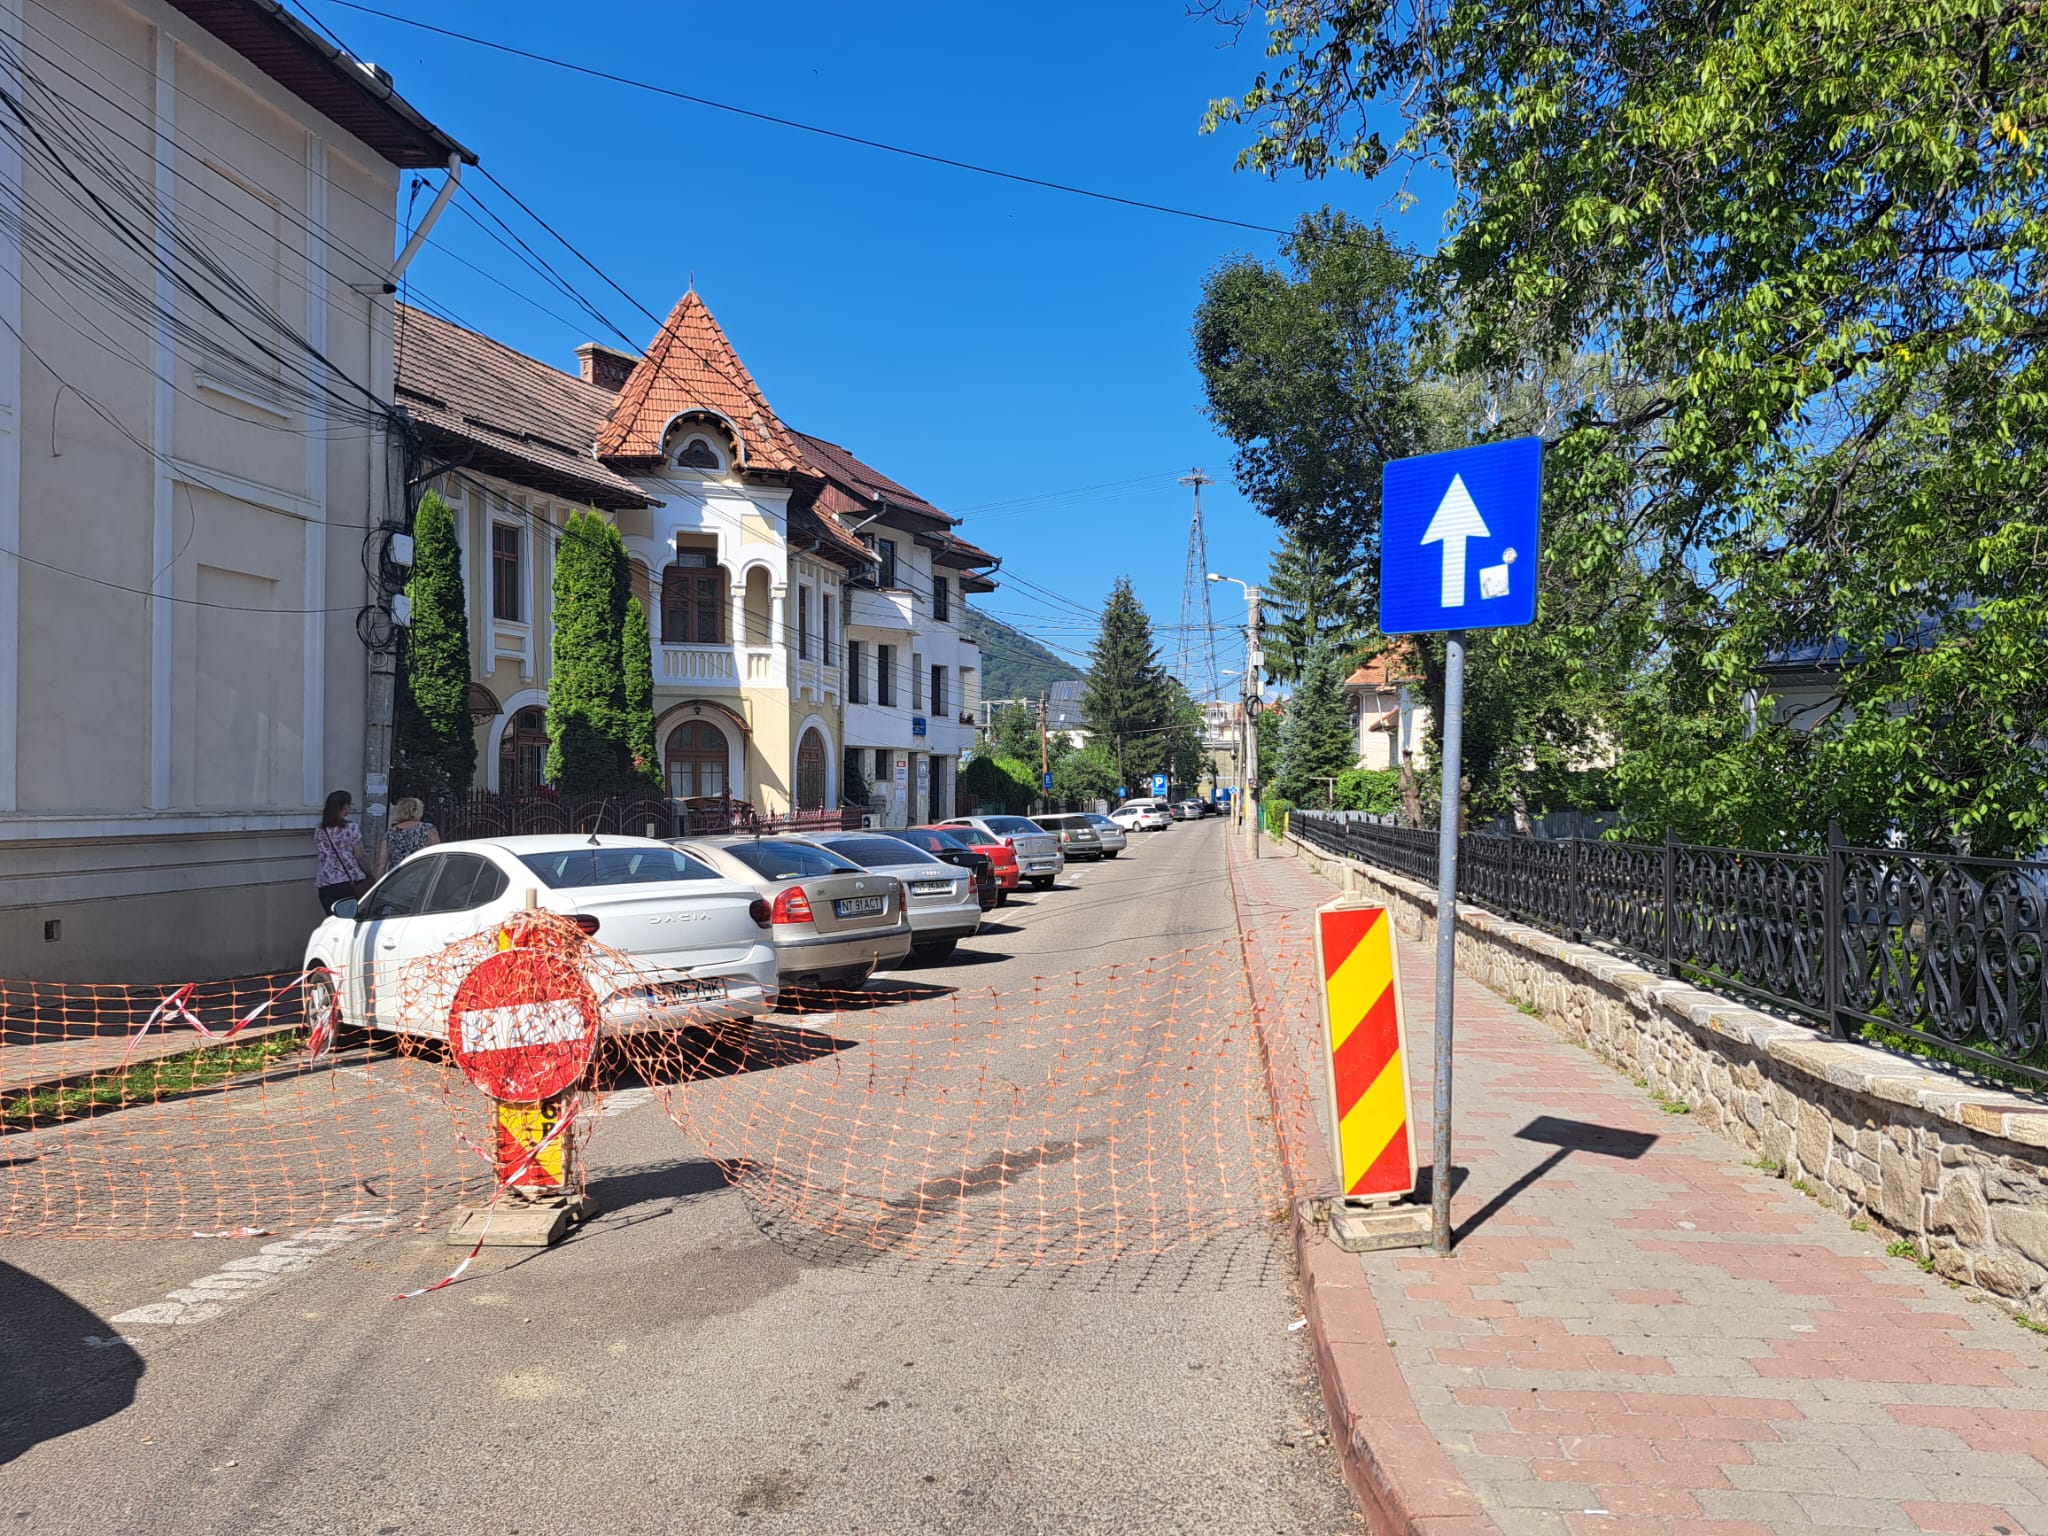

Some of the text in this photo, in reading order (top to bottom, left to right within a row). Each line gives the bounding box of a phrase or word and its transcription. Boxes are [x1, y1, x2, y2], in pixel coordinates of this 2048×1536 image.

[1155, 776, 1164, 788] P
[842, 900, 853, 911] NT
[648, 911, 712, 925] DACIA
